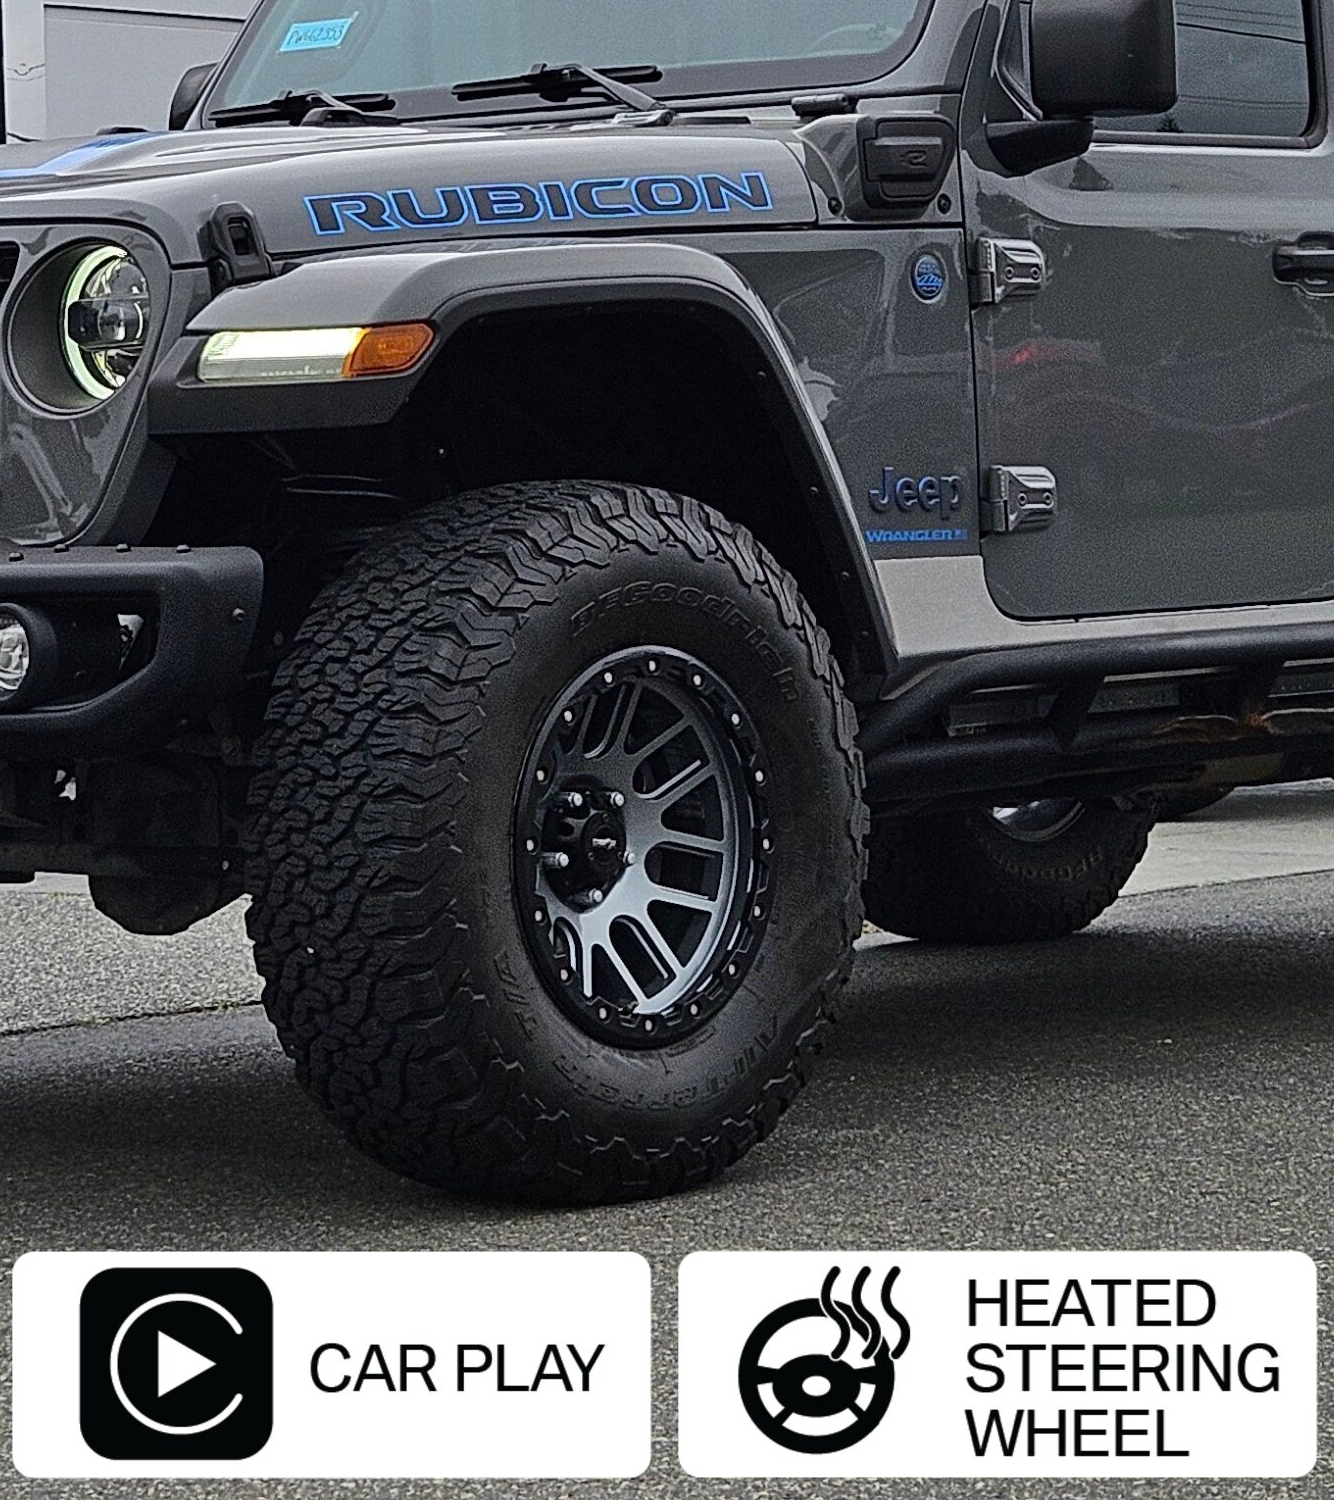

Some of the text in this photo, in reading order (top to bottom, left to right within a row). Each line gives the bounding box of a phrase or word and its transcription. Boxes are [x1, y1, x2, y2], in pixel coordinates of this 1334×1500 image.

[303, 171, 773, 236] RUBICON
[868, 466, 962, 521] Jeep
[866, 528, 953, 542] WRANGLER
